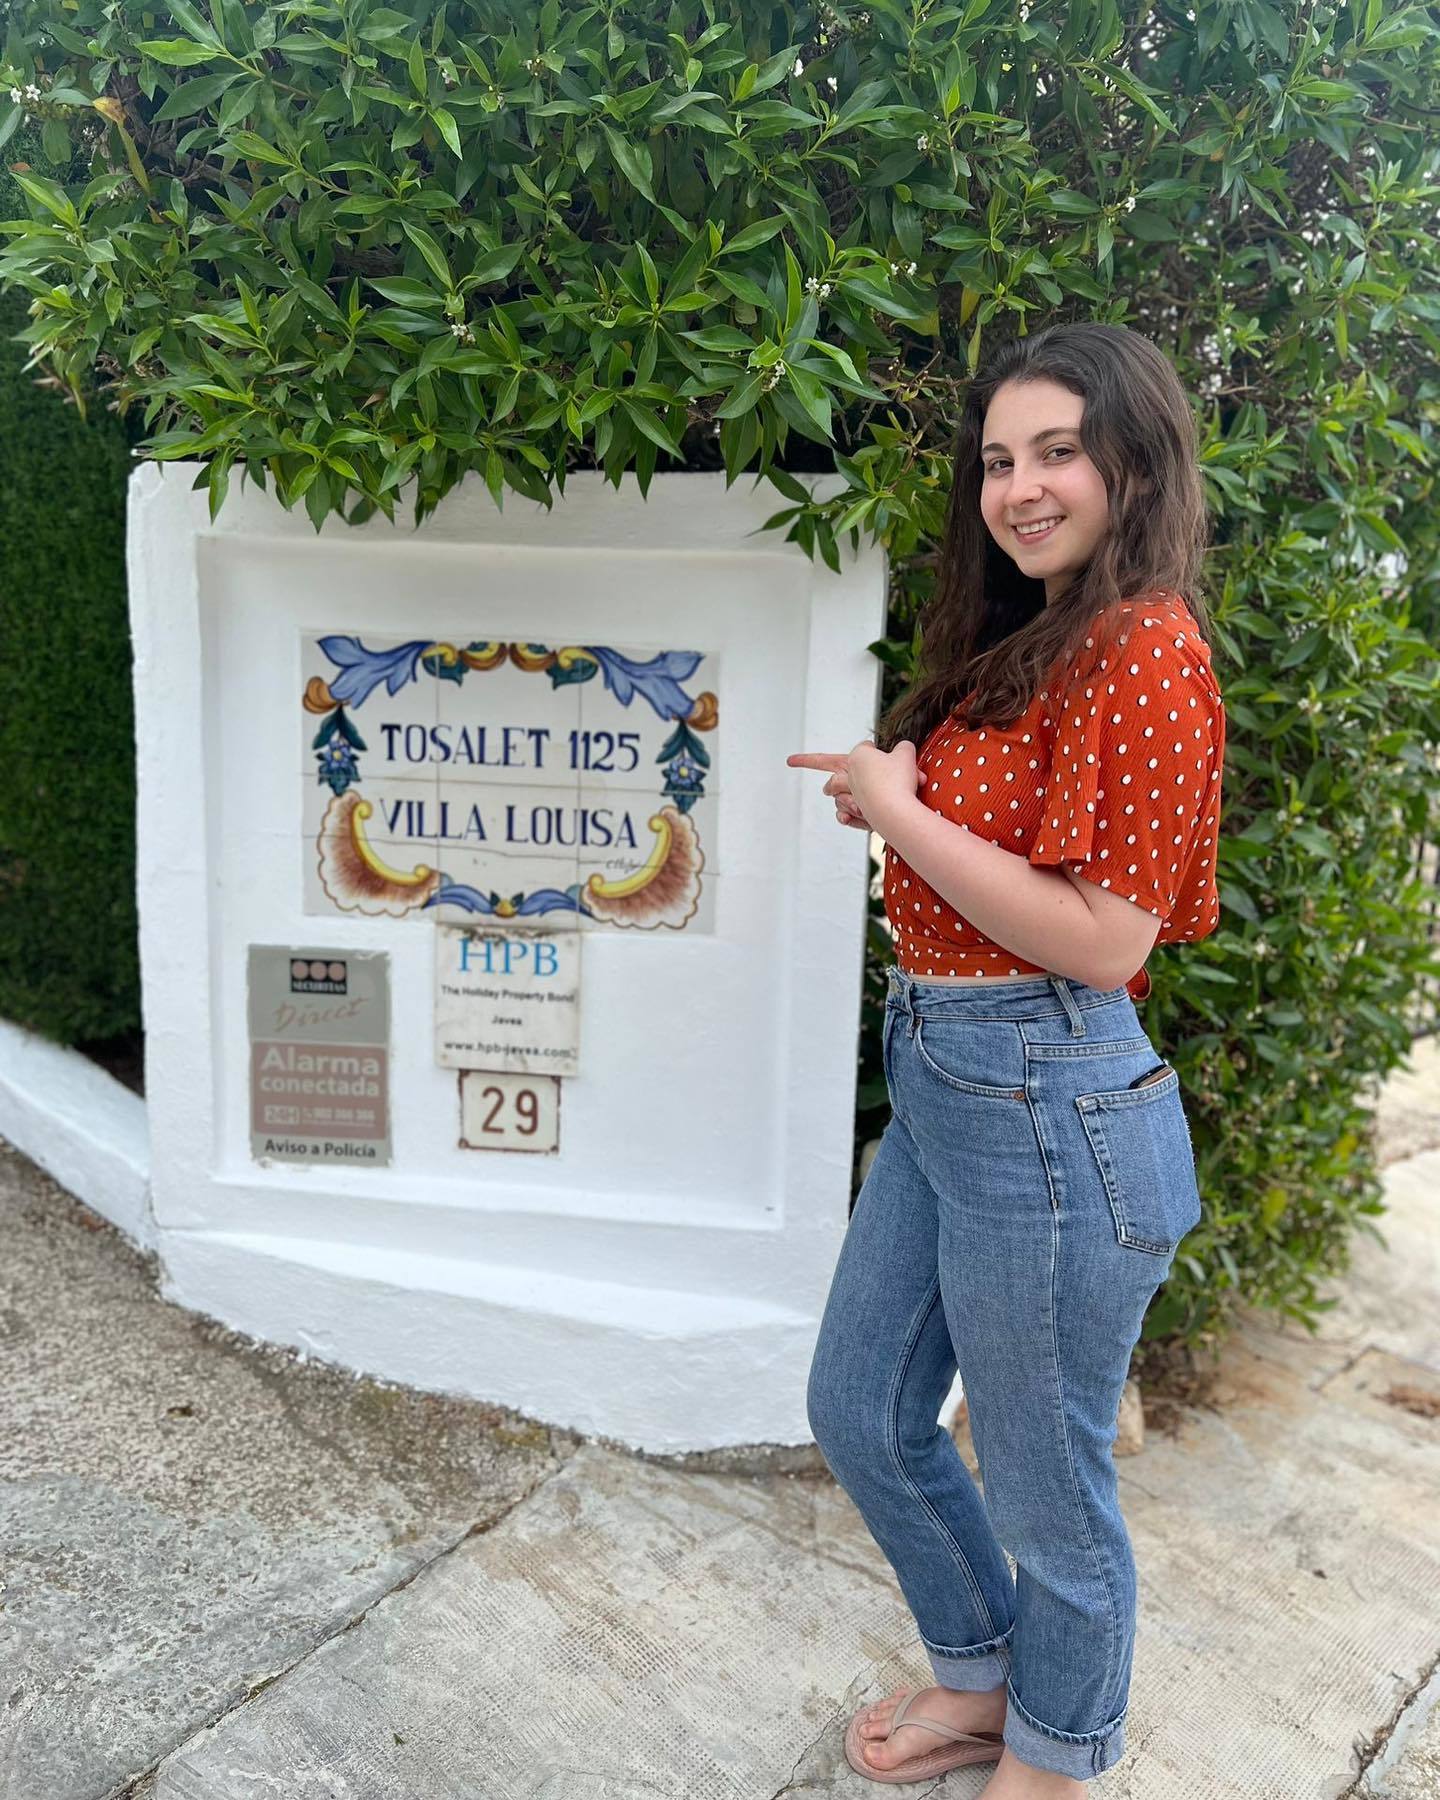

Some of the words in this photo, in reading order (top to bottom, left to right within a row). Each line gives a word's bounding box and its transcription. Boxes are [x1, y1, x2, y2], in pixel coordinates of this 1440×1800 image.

[380, 724, 551, 769] TOSALET
[568, 730, 641, 772] 1125
[379, 799, 488, 841] VILLA
[505, 805, 639, 849] LOUISA
[458, 936, 560, 977] HPB
[441, 985, 460, 996] The
[462, 986, 499, 1000] Holiday
[502, 988, 544, 1003] Property
[547, 992, 576, 1003] Bond
[261, 1047, 380, 1076] Alarma
[260, 1074, 380, 1097] conectada
[481, 1086, 538, 1136] 29
[264, 1139, 308, 1155] Aviso
[311, 1144, 320, 1155] a
